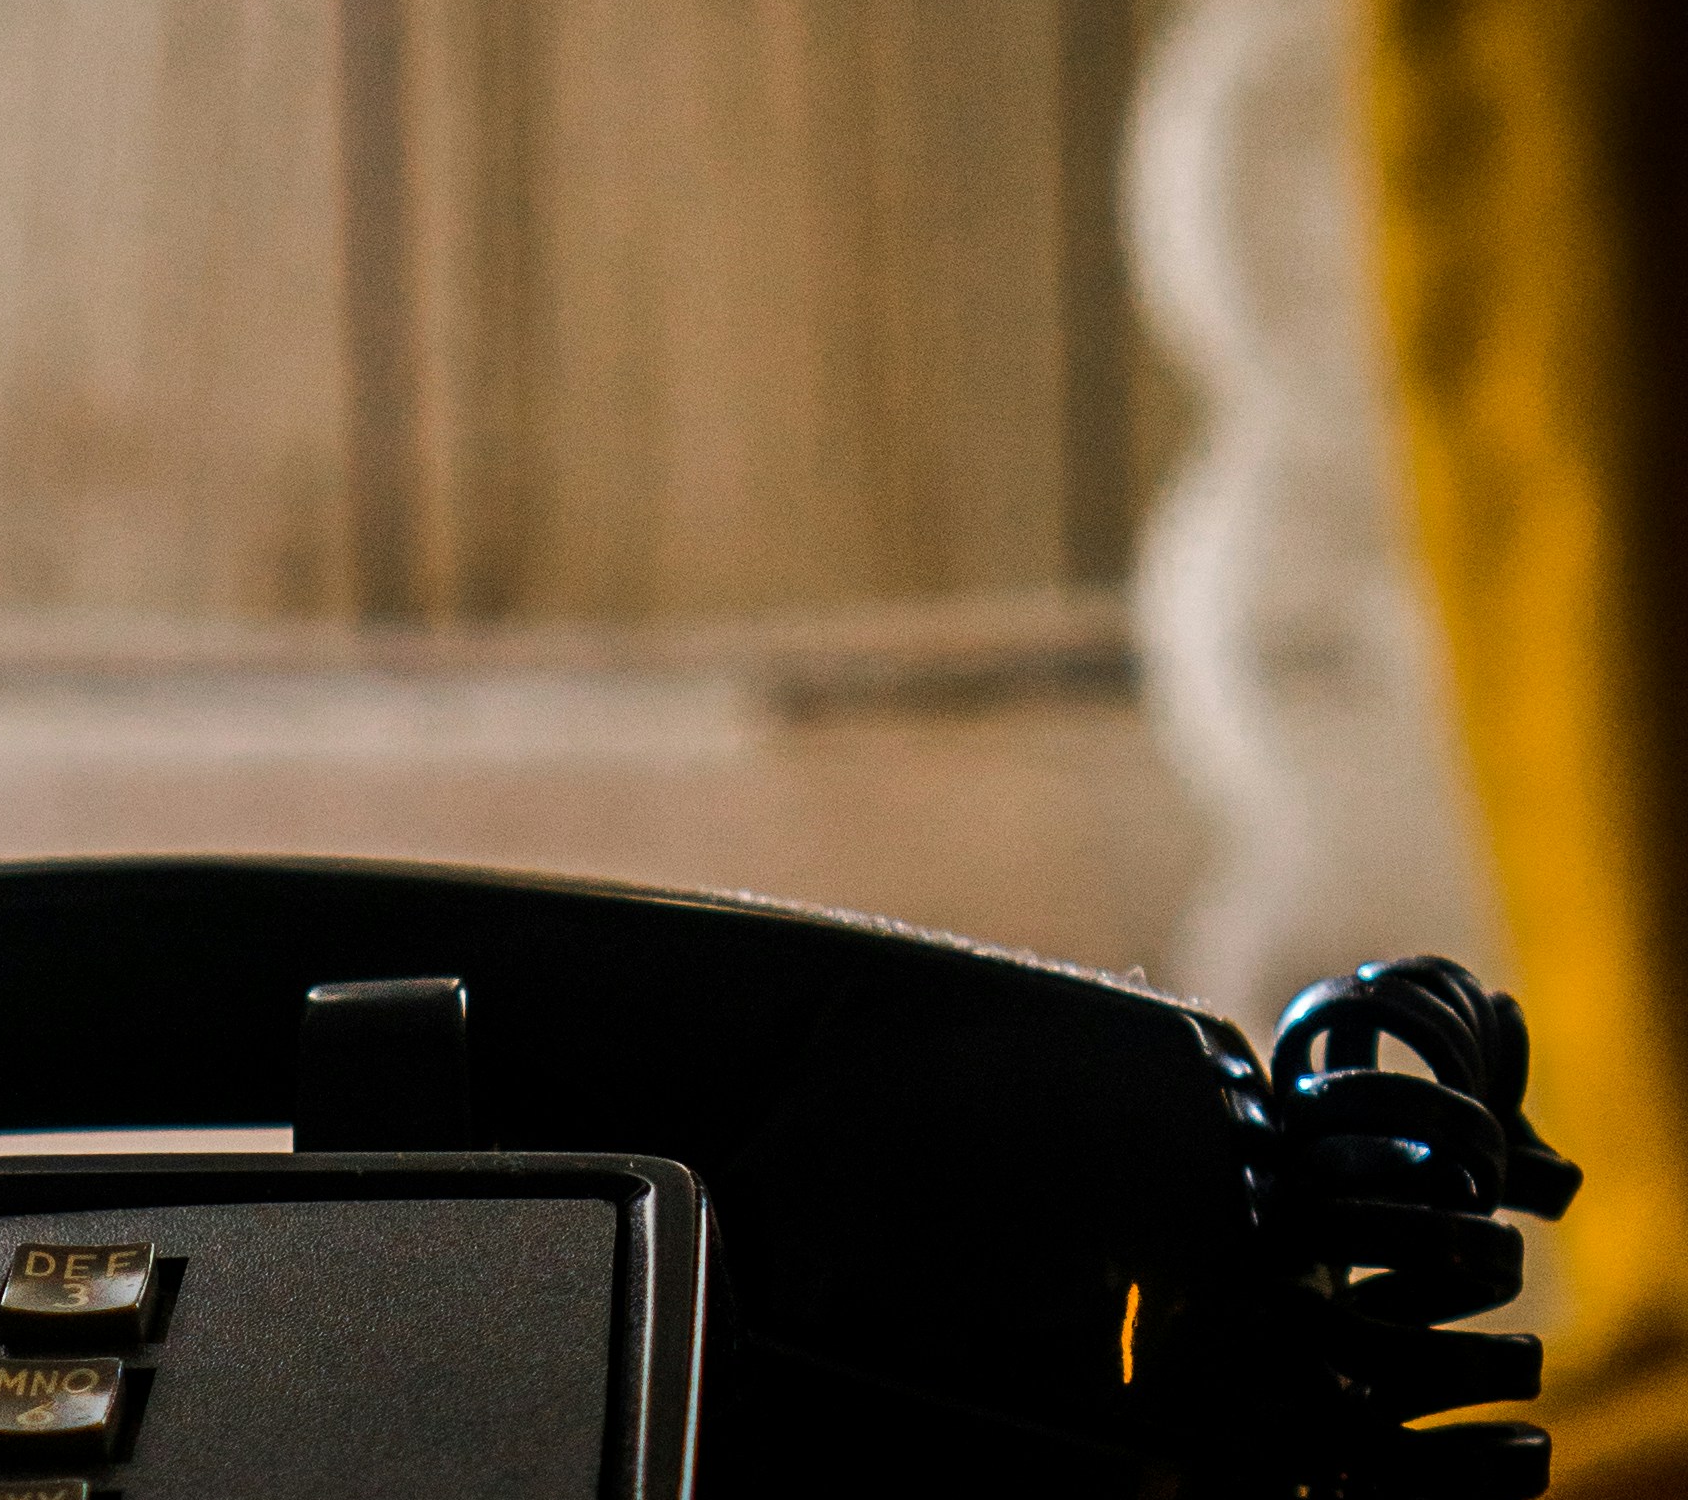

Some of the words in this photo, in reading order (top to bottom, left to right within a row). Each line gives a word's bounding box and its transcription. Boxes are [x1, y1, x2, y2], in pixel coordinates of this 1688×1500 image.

[24, 1250, 138, 1281] DEF
[52, 1282, 91, 1309] 3
[15, 1400, 56, 1426] 6
